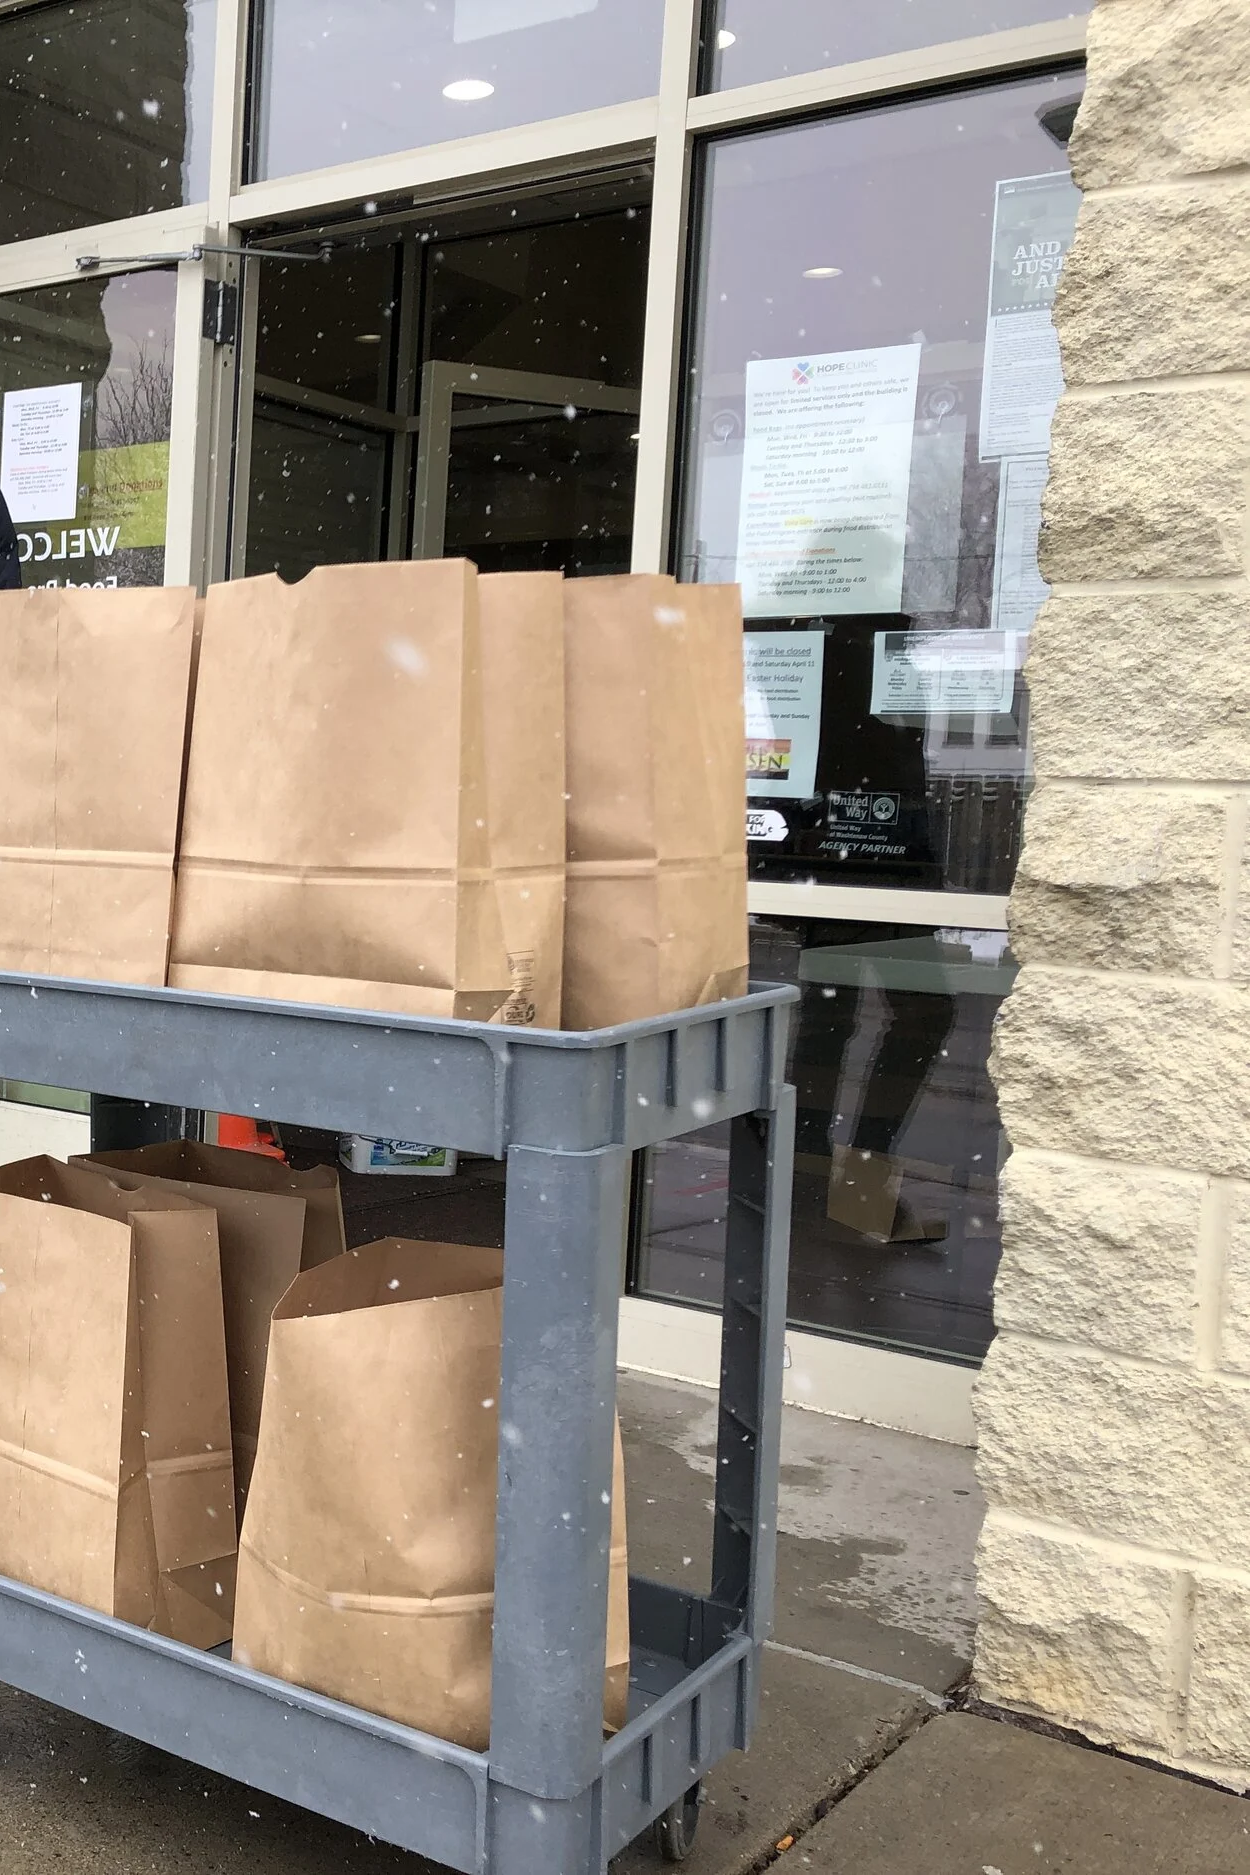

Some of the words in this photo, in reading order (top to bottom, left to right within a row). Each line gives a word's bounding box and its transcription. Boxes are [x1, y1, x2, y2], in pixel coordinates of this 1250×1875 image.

[1013, 241, 1061, 259] AND
[817, 363, 845, 373] HOPE
[846, 359, 878, 371] CLINIC
[813, 394, 836, 402] services
[837, 392, 850, 400] only
[876, 387, 902, 396] building
[798, 404, 822, 413] offering
[759, 647, 773, 655] will
[775, 647, 785, 655] be
[786, 647, 812, 656] closed
[765, 660, 791, 669] Saturday
[792, 660, 806, 668] April
[773, 674, 803, 683] Holiday
[832, 794, 869, 807] United
[846, 806, 867, 820] Way
[849, 824, 862, 832] Way
[818, 841, 860, 851] AGENCY
[860, 843, 906, 854] PARTNER
